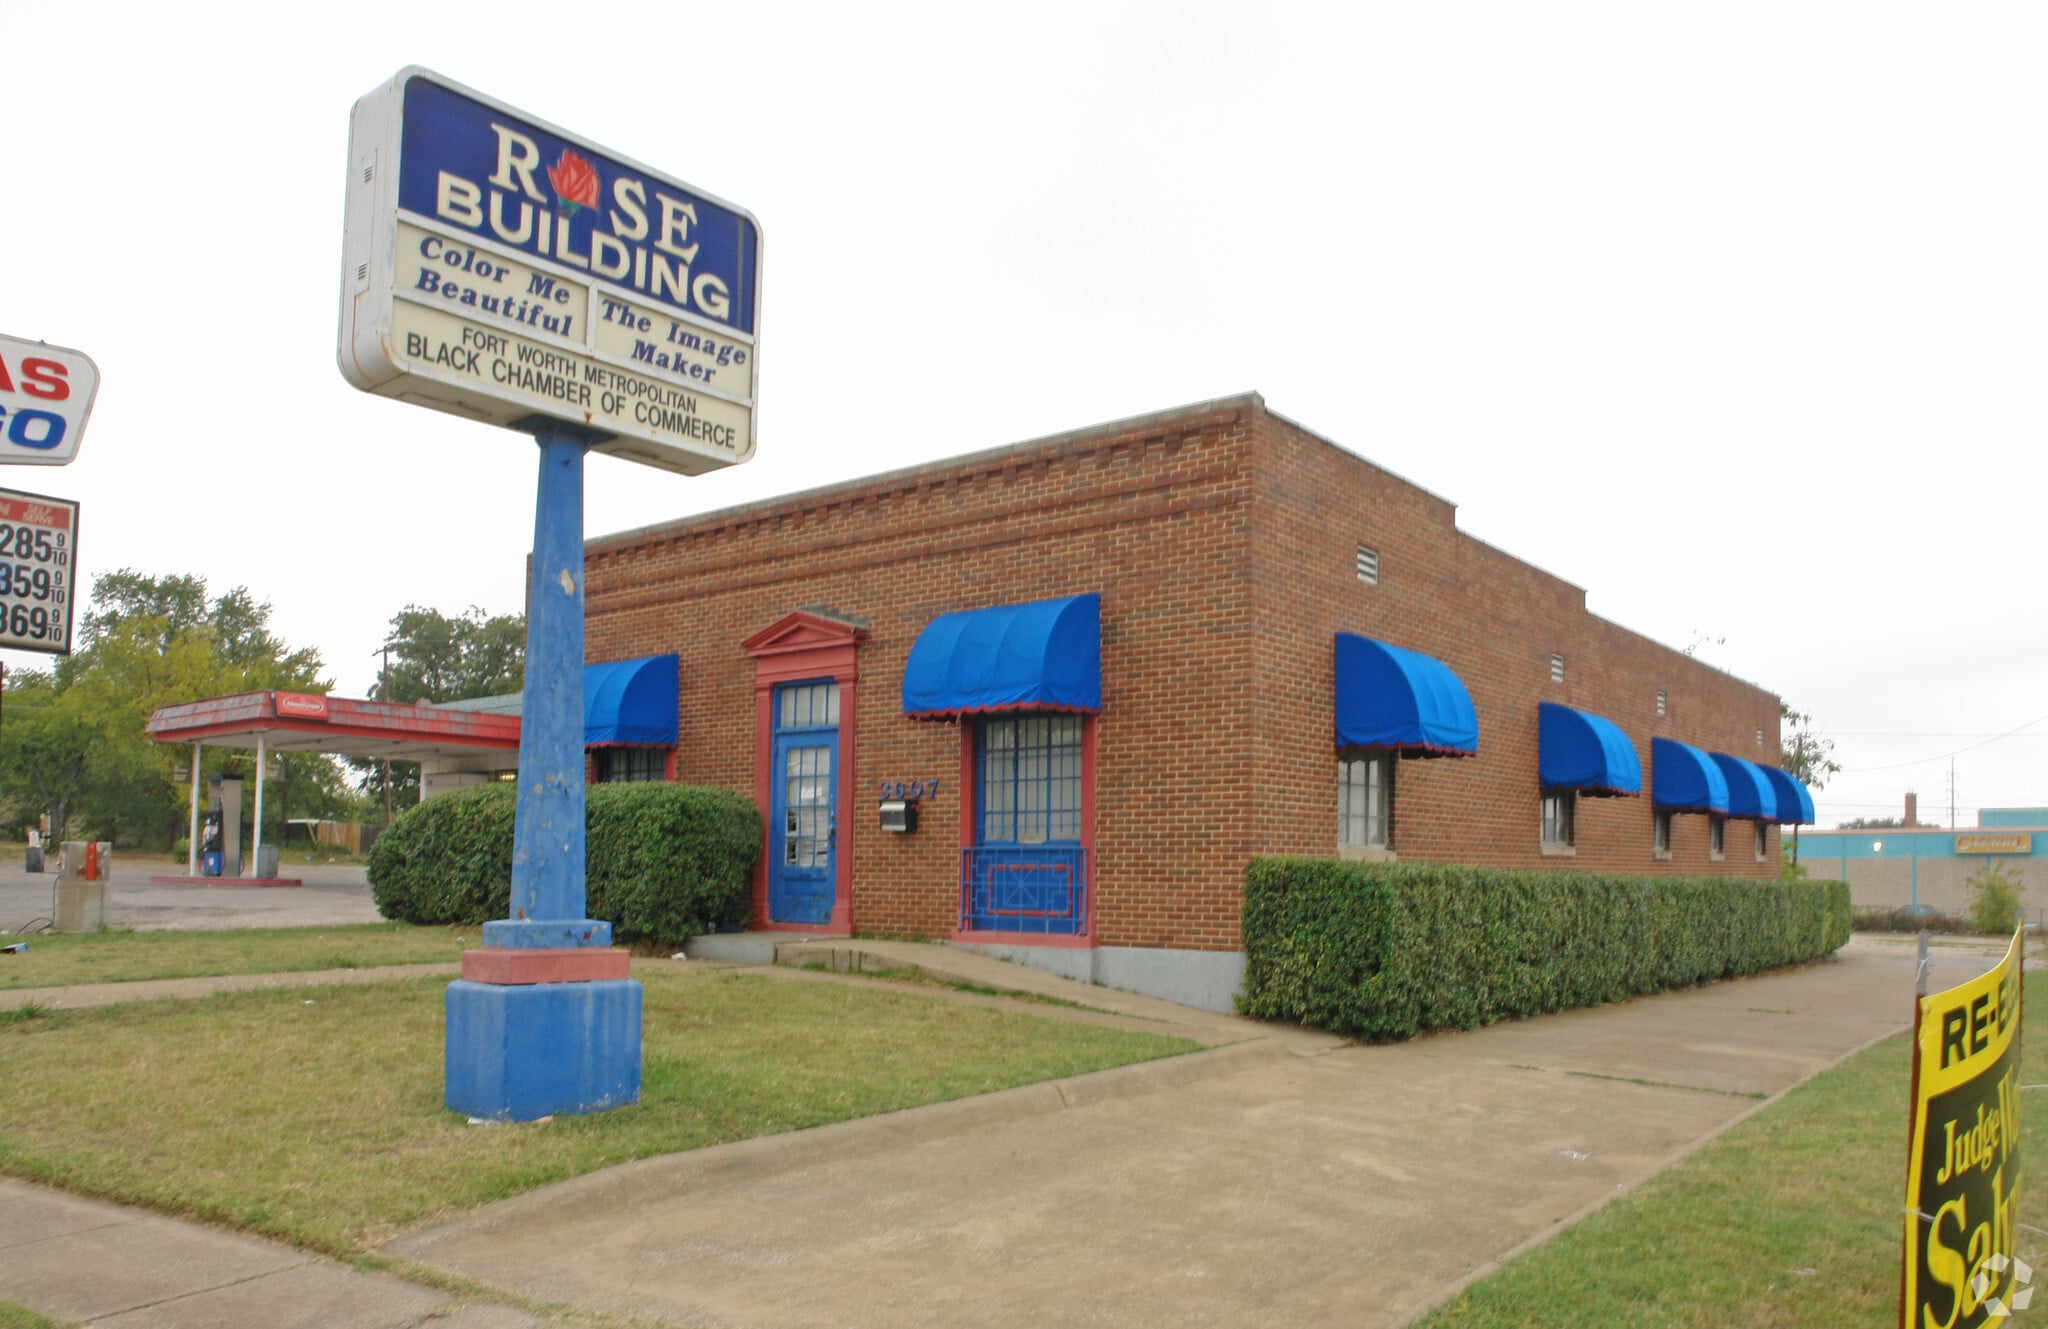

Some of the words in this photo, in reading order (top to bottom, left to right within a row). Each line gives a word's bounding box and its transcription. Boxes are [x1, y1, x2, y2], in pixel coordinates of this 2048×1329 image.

[436, 170, 730, 321] BUILDING
[420, 236, 510, 283] Color
[526, 272, 570, 304] Me
[415, 267, 572, 337] Beautiful
[602, 299, 651, 333] The
[667, 322, 746, 366] Image
[462, 326, 509, 356] FORT
[517, 342, 576, 378] WORTH
[584, 365, 697, 414] METROPOLITAN
[631, 339, 716, 383] Maker
[407, 332, 480, 376] BLACK
[492, 358, 591, 407] CHAMBER
[601, 391, 627, 416] OF
[635, 401, 735, 449] COMMERCE
[0, 403, 67, 450] O
[0, 523, 52, 562] 285
[52, 550, 67, 566] 10
[57, 532, 65, 547] 9
[50, 589, 65, 604] 10
[52, 608, 60, 623] 9
[48, 627, 62, 642] 10
[880, 779, 939, 799] 3607
[1937, 1102, 1999, 1185] Judge
